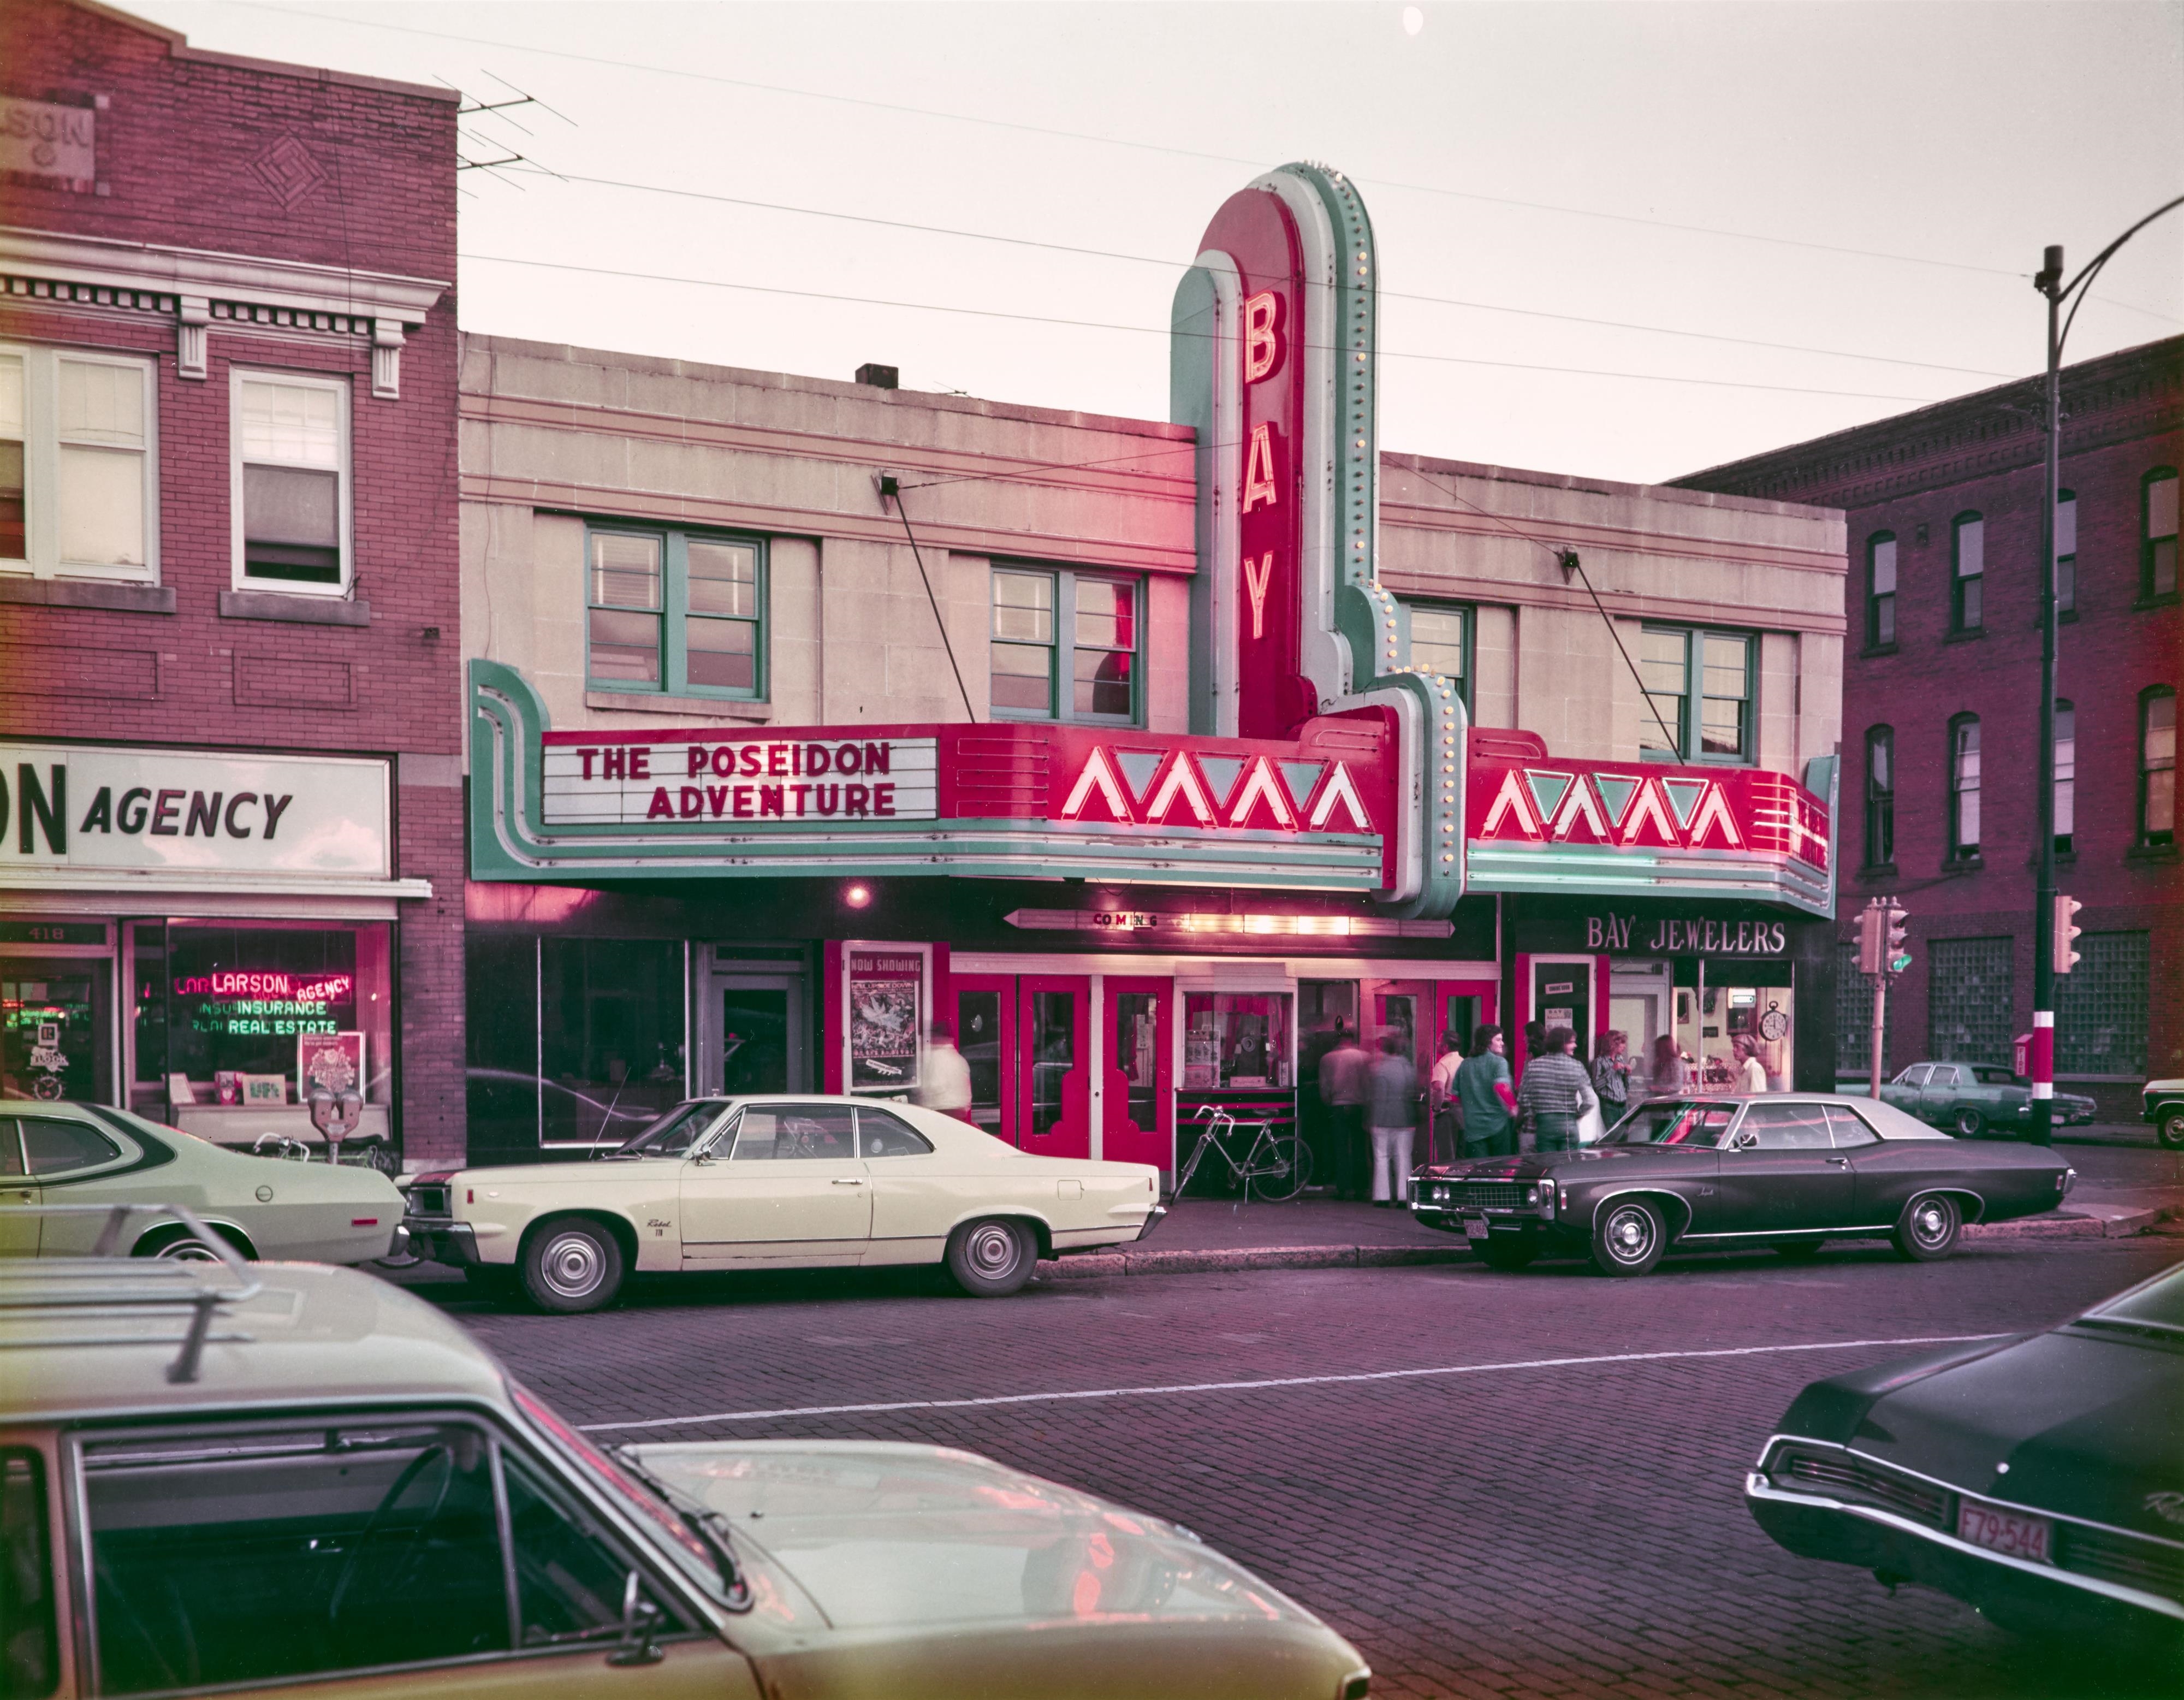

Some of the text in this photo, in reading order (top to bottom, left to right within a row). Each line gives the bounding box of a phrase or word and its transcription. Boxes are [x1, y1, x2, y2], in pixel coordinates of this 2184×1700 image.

[0, 108, 89, 147] SON
[1242, 289, 1284, 639] BAY
[576, 742, 891, 780] THE POSEIDON
[0, 763, 293, 855] N AGENCY
[646, 783, 895, 819] ADVENTURE
[29, 927, 64, 940] 418
[1587, 911, 1785, 954] BAY JEWELERS
[852, 959, 921, 972] NOW SHOWING
[212, 973, 288, 993] LARSON
[296, 975, 350, 1002] AGENCY
[237, 1000, 327, 1016] INSURANCE
[228, 1019, 270, 1035] REAL
[275, 1020, 336, 1035] ESTATE
[1962, 1507, 2044, 1557] F79-544
